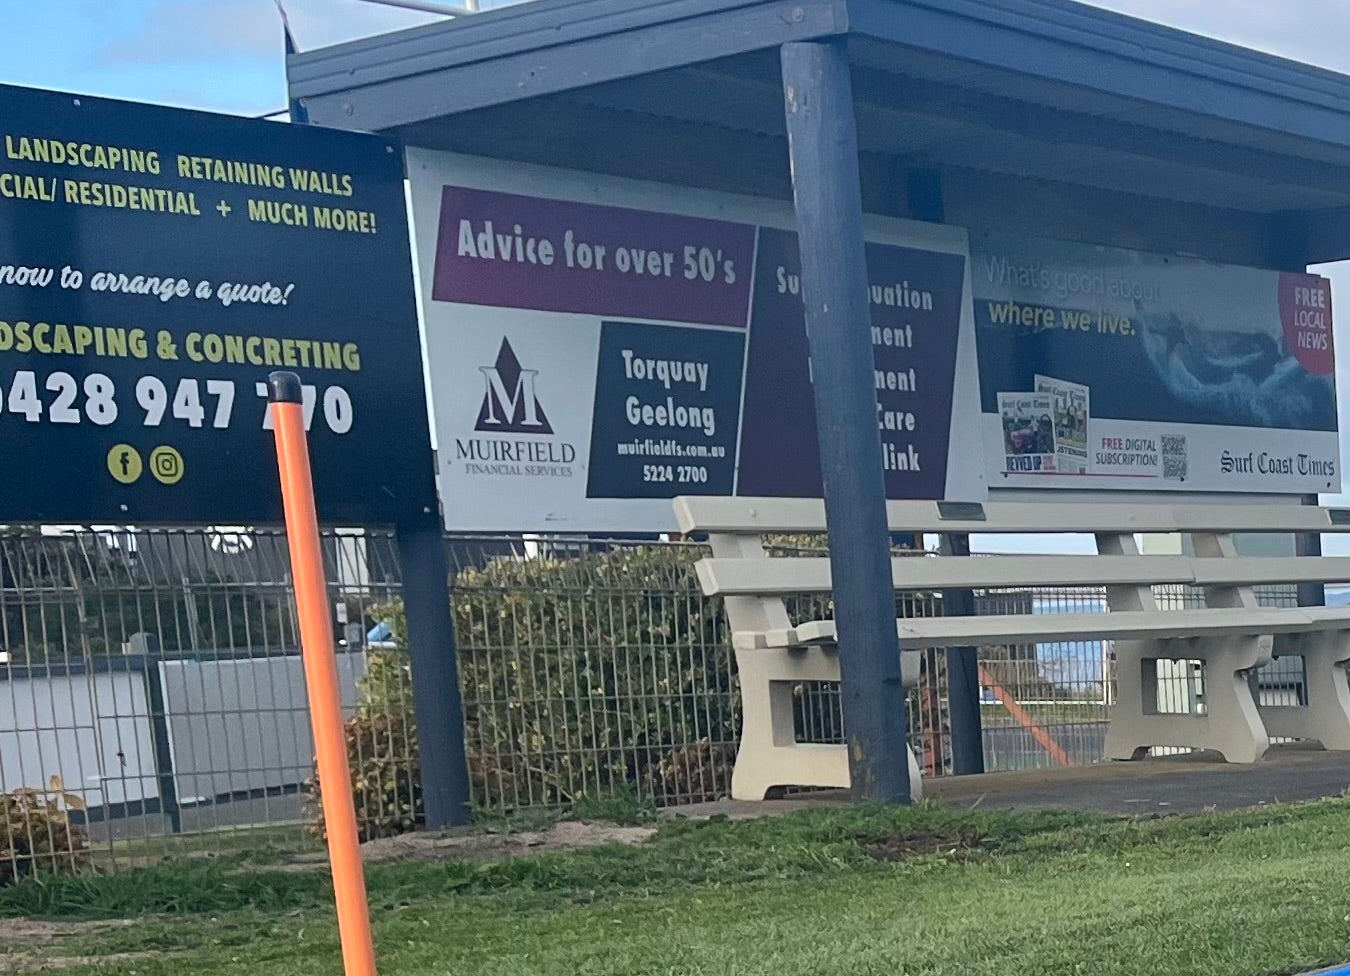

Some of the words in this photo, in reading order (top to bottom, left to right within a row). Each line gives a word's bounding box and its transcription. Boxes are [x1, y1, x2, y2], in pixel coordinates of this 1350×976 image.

[6, 135, 160, 175] LANDSCAPING
[178, 155, 285, 189] RETAINING
[289, 168, 353, 197] WALLS
[65, 179, 200, 216] RESIDENTIAL
[248, 200, 308, 227] MUCH
[314, 207, 377, 234] MORE!
[458, 219, 554, 267] Advice
[564, 229, 606, 271] for
[616, 246, 674, 278] over
[683, 246, 736, 285] 50's
[0, 265, 54, 288] now
[60, 265, 83, 290] to
[90, 270, 190, 302] arrange
[195, 280, 213, 300] a
[217, 280, 294, 307] quote!
[1294, 287, 1325, 308] FREE
[988, 297, 1054, 328] where
[1061, 310, 1091, 332] we
[1097, 307, 1136, 336] live.
[1294, 311, 1326, 329] LOCAL
[156, 331, 178, 361] &
[186, 332, 360, 371] CONCRETING
[1298, 331, 1328, 351] NEWS
[622, 349, 709, 392] Torquay
[0, 371, 118, 427] 428
[135, 375, 235, 429] 947
[626, 396, 715, 436] Geelong
[455, 438, 576, 464] MUIRFIELD
[1102, 437, 1123, 450] FREE
[1125, 438, 1156, 451] DIGITAL
[1220, 450, 1253, 474] Surf
[1257, 452, 1294, 475] Coast
[1297, 454, 1334, 477] Times
[465, 463, 524, 476] FINANCIAL
[525, 465, 573, 478] SERVICES
[643, 465, 673, 482] 5224
[677, 466, 708, 483] 2700
